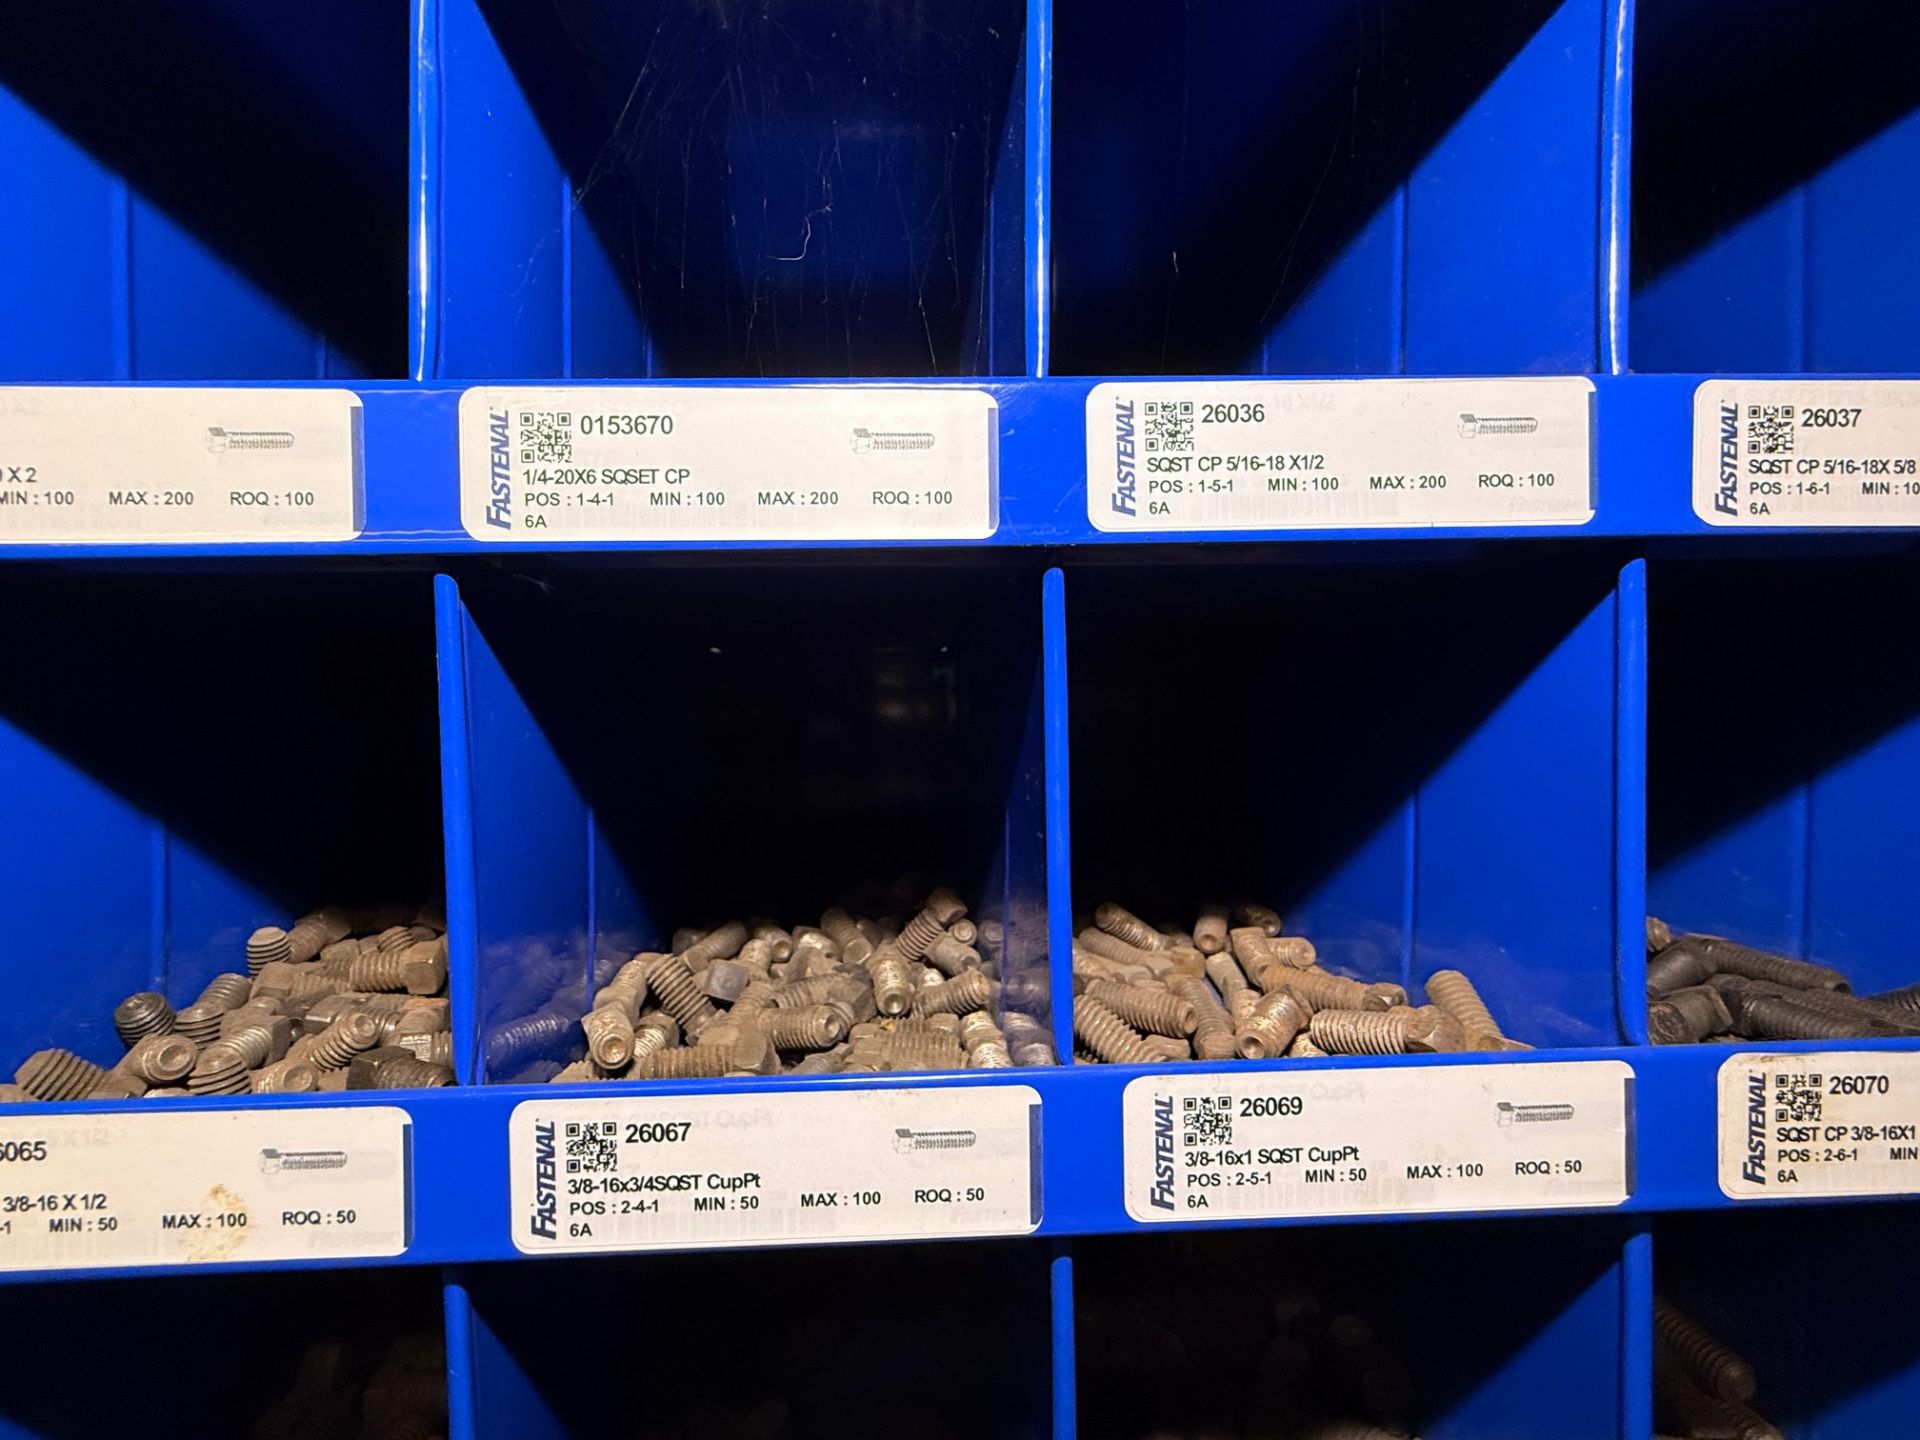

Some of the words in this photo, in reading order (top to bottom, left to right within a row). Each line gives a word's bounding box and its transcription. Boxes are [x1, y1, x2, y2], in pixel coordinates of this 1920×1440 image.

[1202, 404, 1264, 423] 26036
[1802, 409, 1862, 427] 26037
[581, 416, 672, 434] 0153670
[1112, 401, 1135, 516] FASTENAL
[1148, 457, 1192, 472] SQST
[1198, 457, 1222, 471] CP
[1227, 456, 1284, 471] 5/16-18
[1289, 455, 1323, 470] X1/2
[1715, 403, 1738, 516] FASTENAL
[1749, 459, 1792, 474] SQST
[1797, 460, 1819, 474] CP
[1824, 460, 1890, 474] 5/16-18X
[1894, 460, 1916, 474] 5/8
[486, 411, 511, 529] FASTENAL
[523, 469, 596, 484] 1/4-20X6
[602, 469, 659, 484] SQSET
[665, 469, 689, 484] CP
[1150, 480, 1182, 493] POS
[1199, 480, 1232, 492] 1-5-1
[1269, 478, 1296, 491] MIN
[1312, 478, 1338, 490] 100
[1370, 476, 1404, 489] MAX
[1420, 476, 1446, 488] 200
[1479, 474, 1513, 487] ROQ
[1528, 474, 1554, 486] 100
[1750, 482, 1781, 495] POS
[1797, 482, 1829, 495] 1-6-1
[1862, 482, 1890, 494] MIN
[45, 492, 73, 504] 100
[110, 492, 147, 504] MAX
[165, 492, 193, 505] 200
[231, 492, 268, 505] ROQ
[286, 492, 313, 505] 100
[526, 493, 560, 506] POS
[577, 493, 613, 505] 1-4-1
[651, 493, 680, 505] MIN
[697, 492, 724, 505] 100
[759, 492, 794, 504] MAX
[811, 492, 838, 504] 200
[873, 492, 909, 504] ROQ
[926, 492, 952, 504] 100
[1150, 502, 1170, 514] 6A
[1750, 503, 1770, 515] 6A
[525, 515, 546, 527] 6A
[1829, 1075, 1889, 1095] 26070
[1240, 1097, 1302, 1117] 26069
[626, 1122, 691, 1143] 26067
[1743, 1073, 1766, 1185] FASTENAL
[1777, 1127, 1821, 1143] SQST
[1824, 1126, 1848, 1142] CP
[1851, 1125, 1915, 1141] 3/8-16X1
[1151, 1093, 1174, 1211] FASTENAL
[1185, 1150, 1251, 1167] 3/8-16x1
[1258, 1148, 1303, 1164] SQST
[1308, 1146, 1359, 1165] CupPt
[1778, 1149, 1811, 1162] POS
[1824, 1148, 1857, 1161] 2-6-1
[1890, 1147, 1918, 1160] MIN
[531, 1119, 556, 1240] FASTENAL
[1188, 1173, 1221, 1187] POS
[1236, 1172, 1271, 1185] 2-5-1
[1306, 1169, 1334, 1182] MIN
[1349, 1168, 1367, 1181] 50
[1407, 1165, 1442, 1179] MAX
[1457, 1164, 1483, 1177] 100
[1515, 1161, 1550, 1175] ROQ
[1565, 1160, 1582, 1173] 50
[1777, 1169, 1798, 1183] 6A
[568, 1175, 702, 1194] 3/8-16x3/4SQST
[707, 1173, 760, 1192] CupPt
[3, 1195, 58, 1212] 3/8-16
[81, 1194, 107, 1209] 1/2
[570, 1201, 605, 1215] POS
[621, 1199, 658, 1214] 2-4-1
[695, 1197, 725, 1211] MIN
[741, 1196, 759, 1209] 50
[801, 1193, 837, 1207] MAX
[853, 1192, 881, 1205] 100
[915, 1189, 951, 1203] ROQ
[967, 1188, 984, 1201] 50
[1188, 1195, 1208, 1208] 6A
[50, 1218, 82, 1232] MIN
[98, 1217, 117, 1231] 50
[163, 1214, 201, 1229] MAX
[217, 1213, 247, 1227] 100
[283, 1211, 321, 1225] ROQ
[337, 1210, 356, 1224] 50
[570, 1223, 592, 1237] 6A
